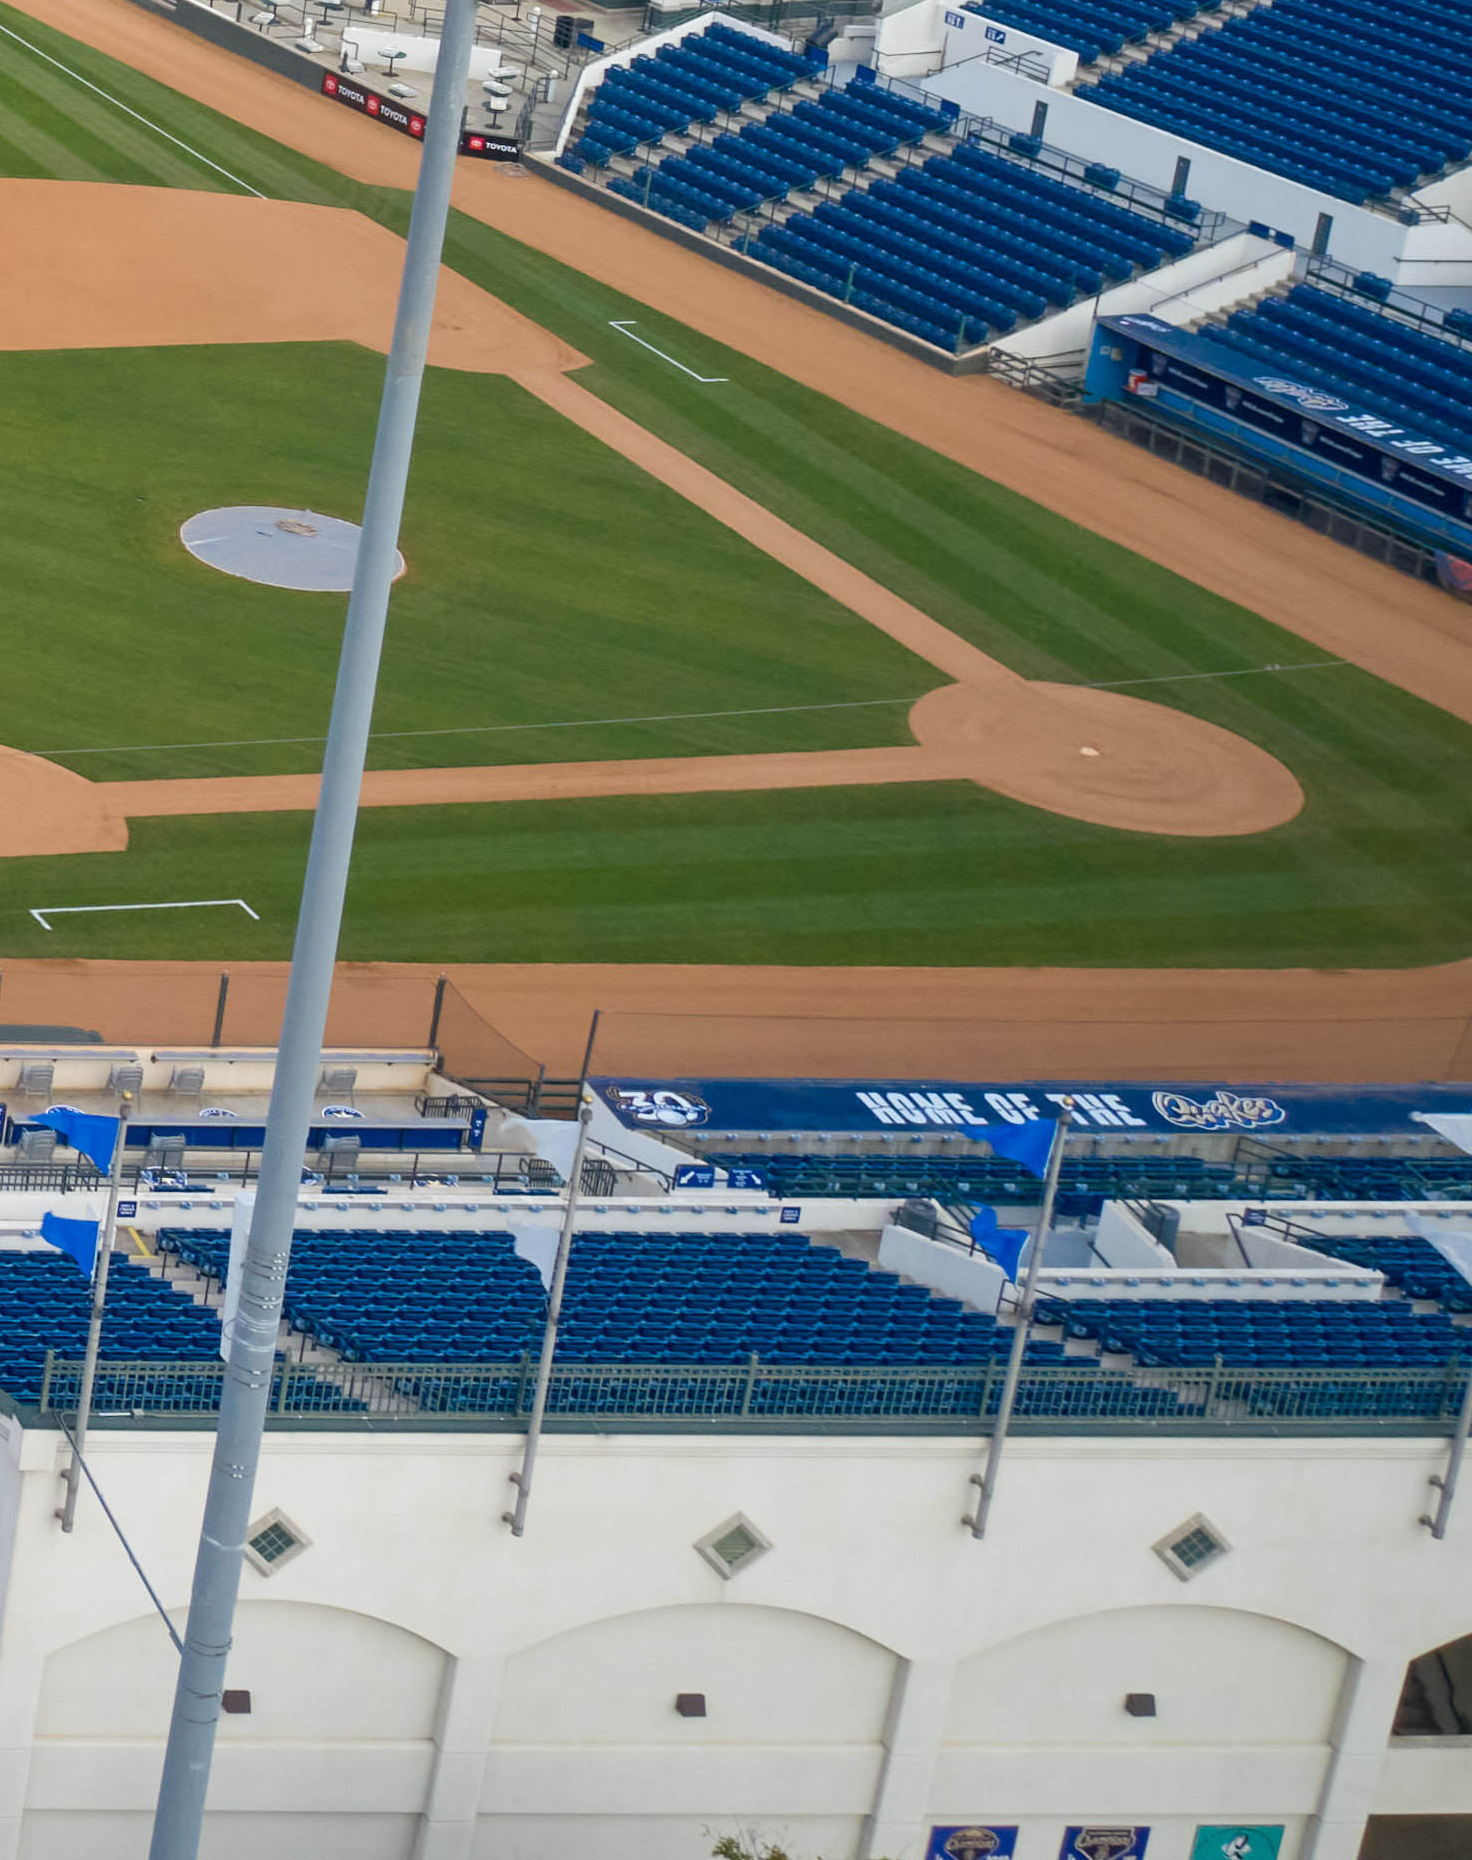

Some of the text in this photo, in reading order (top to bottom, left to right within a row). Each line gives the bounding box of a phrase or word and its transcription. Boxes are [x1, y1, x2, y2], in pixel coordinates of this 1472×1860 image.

[338, 84, 365, 104] TOYOTA
[380, 105, 408, 126] TOYOTA
[486, 142, 517, 154] TOYOTA
[856, 1091, 1286, 1129] HOME OF THE Quakes
